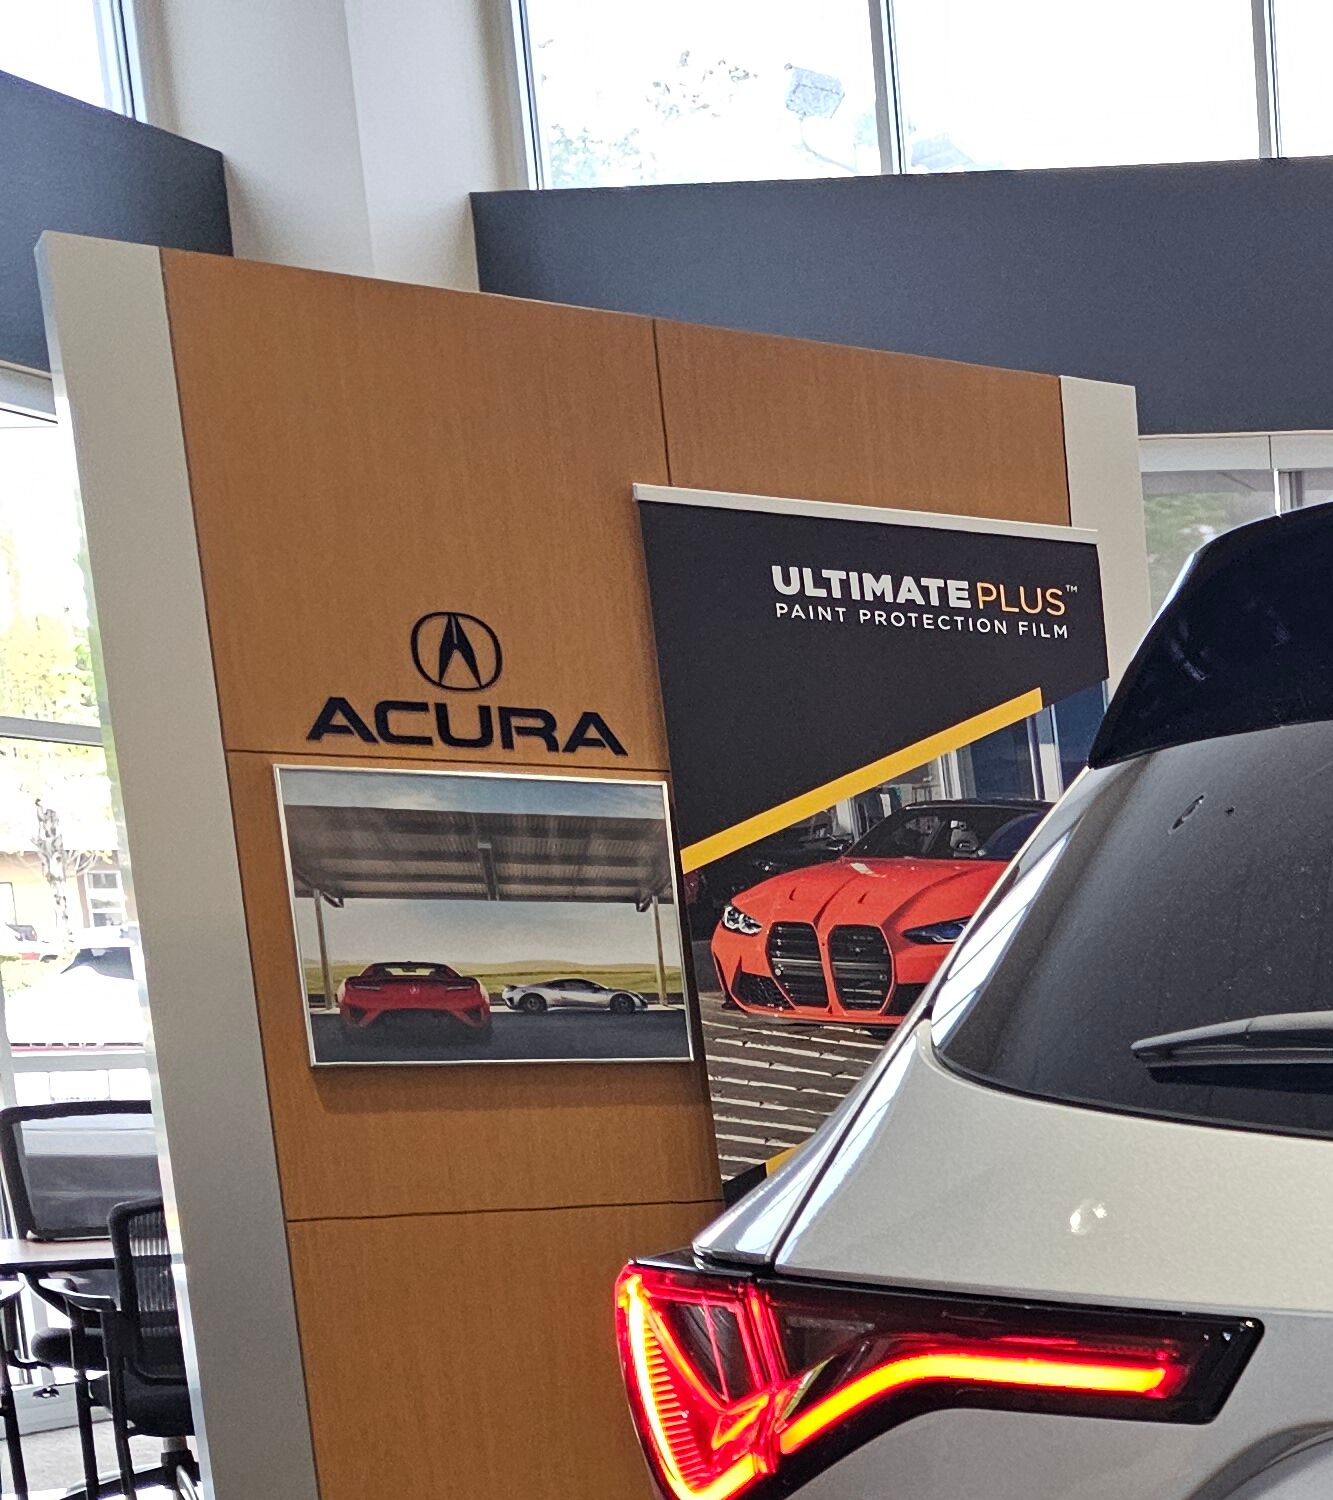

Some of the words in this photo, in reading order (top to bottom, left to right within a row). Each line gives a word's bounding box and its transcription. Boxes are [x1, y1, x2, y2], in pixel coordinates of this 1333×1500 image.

[775, 603, 846, 622] PAINT
[859, 610, 1008, 635] PROTECTION
[1018, 622, 1068, 639] FILM
[305, 696, 629, 757] ACURA
